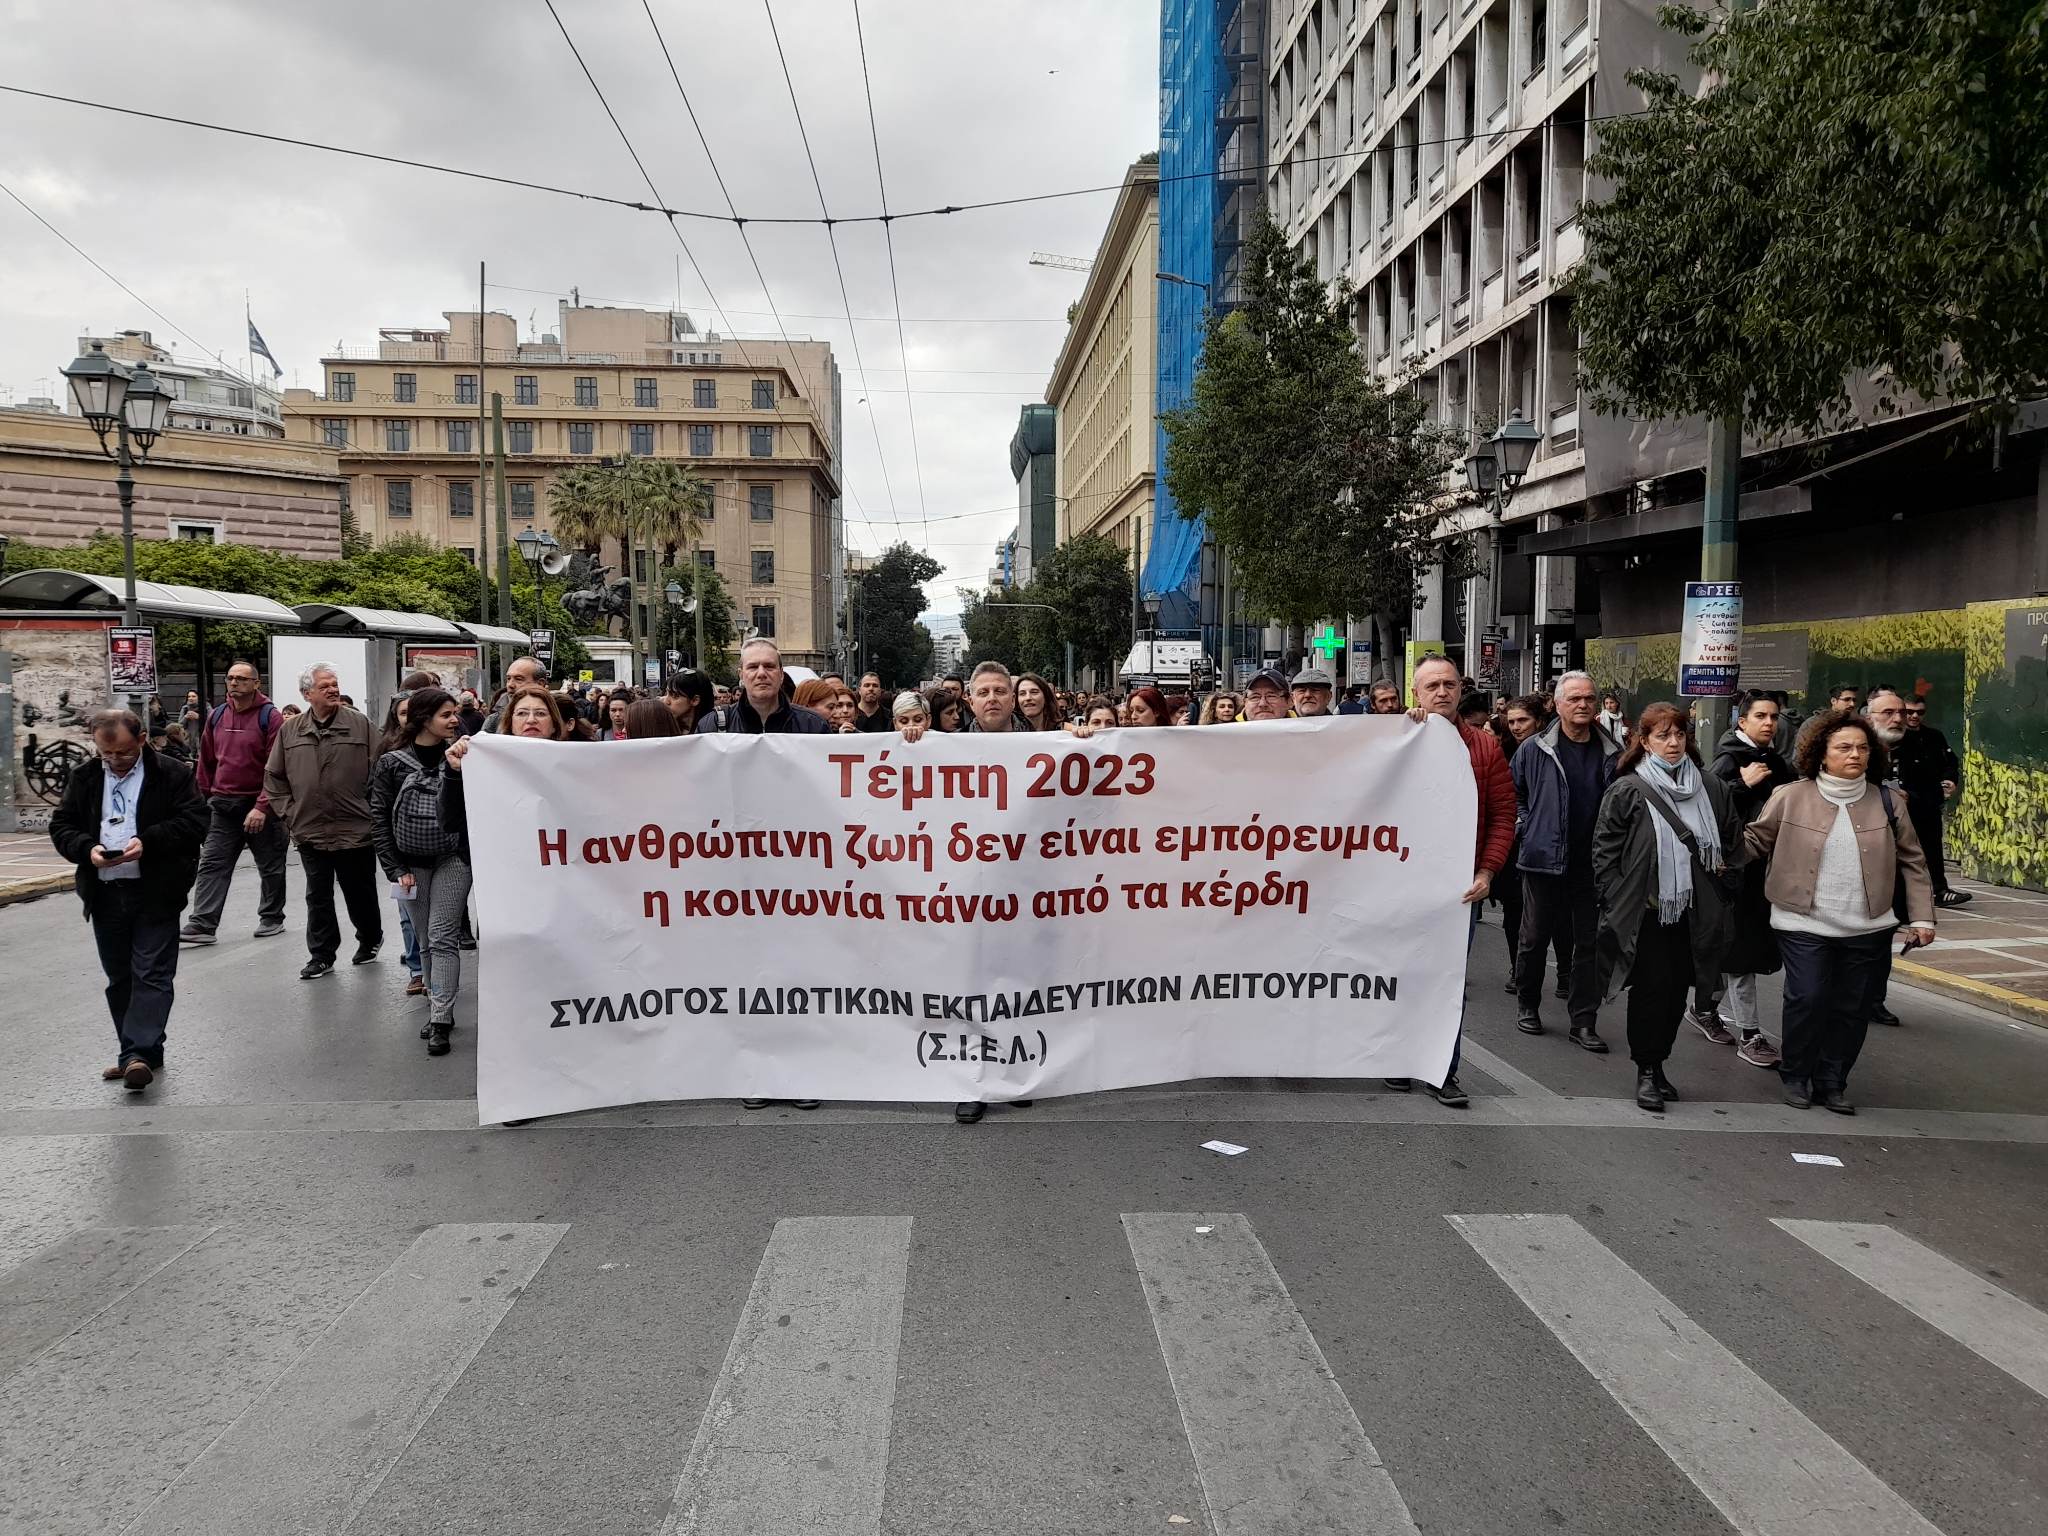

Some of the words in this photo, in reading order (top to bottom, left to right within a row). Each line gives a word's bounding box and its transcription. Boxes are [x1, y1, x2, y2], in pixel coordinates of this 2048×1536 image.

[829, 751, 1008, 811] Τέμπη
[1026, 753, 1156, 798] 2023
[538, 829, 567, 866] Η
[582, 820, 833, 869] ανθρώπινη
[844, 822, 933, 873] ζωή
[947, 822, 1026, 863] δεν
[1039, 818, 1141, 860] είναι
[1155, 813, 1411, 862] εμπόρευμα,
[643, 891, 670, 928] η
[685, 880, 885, 919] κοινωνία
[895, 883, 1019, 924] πάνω
[1032, 874, 1110, 917] από
[1121, 882, 1169, 909] τα
[1181, 868, 1310, 915] κέρδη
[549, 987, 729, 1029] ΣΥΛΛΟΓΟΣ
[738, 986, 914, 1018] ΙΔΙΩΤΙΚΩΝ
[922, 975, 1182, 1023] ΕΚΠΑΙΔΕΥΤΙΚΩΝ
[1190, 972, 1399, 1001] ΛΕΙΤΟΥΡΓΩΝ
[916, 1029, 1048, 1068] (Σ.Ι.Ε.Λ.)
